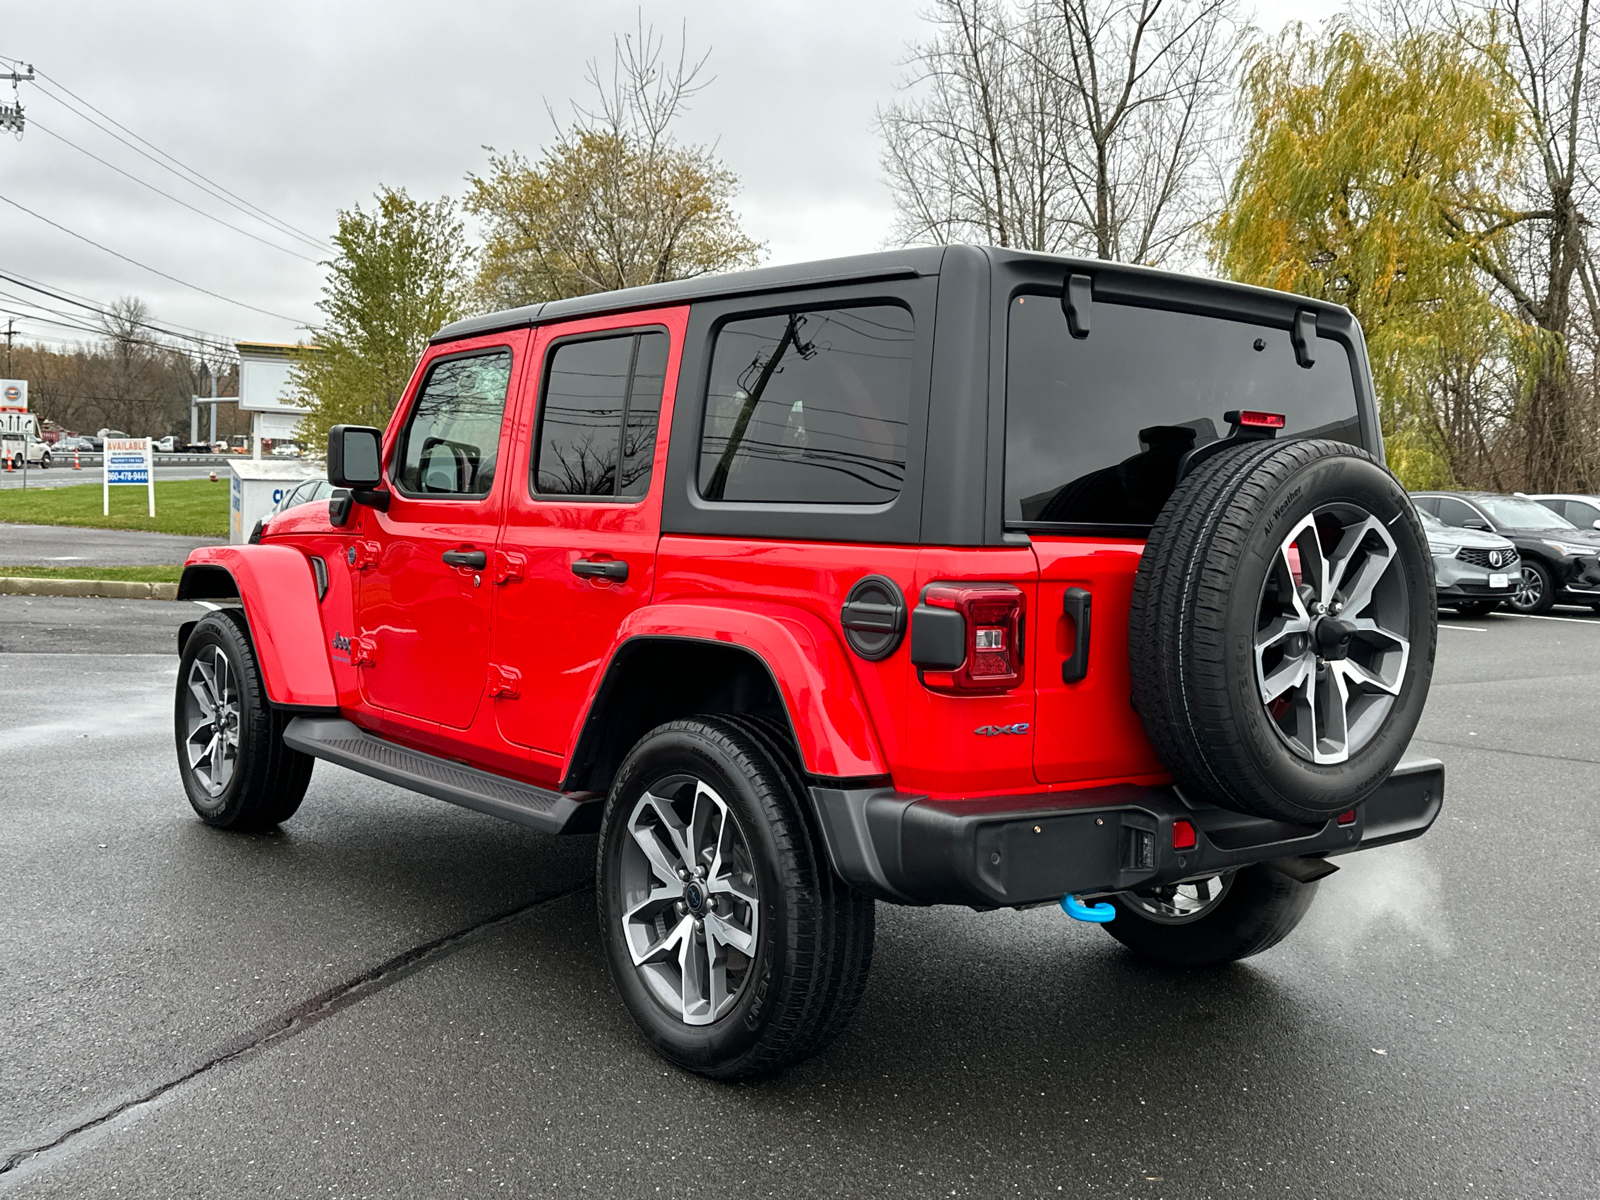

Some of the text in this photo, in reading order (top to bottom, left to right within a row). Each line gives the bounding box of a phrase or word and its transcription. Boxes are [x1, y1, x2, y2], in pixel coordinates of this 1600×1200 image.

[107, 441, 147, 451] AVAILABLE
[1263, 485, 1302, 538] All-Weather
[973, 723, 1030, 737] 4xe
[690, 746, 726, 775] 255/60R20
[749, 916, 776, 1018] NEXEN
